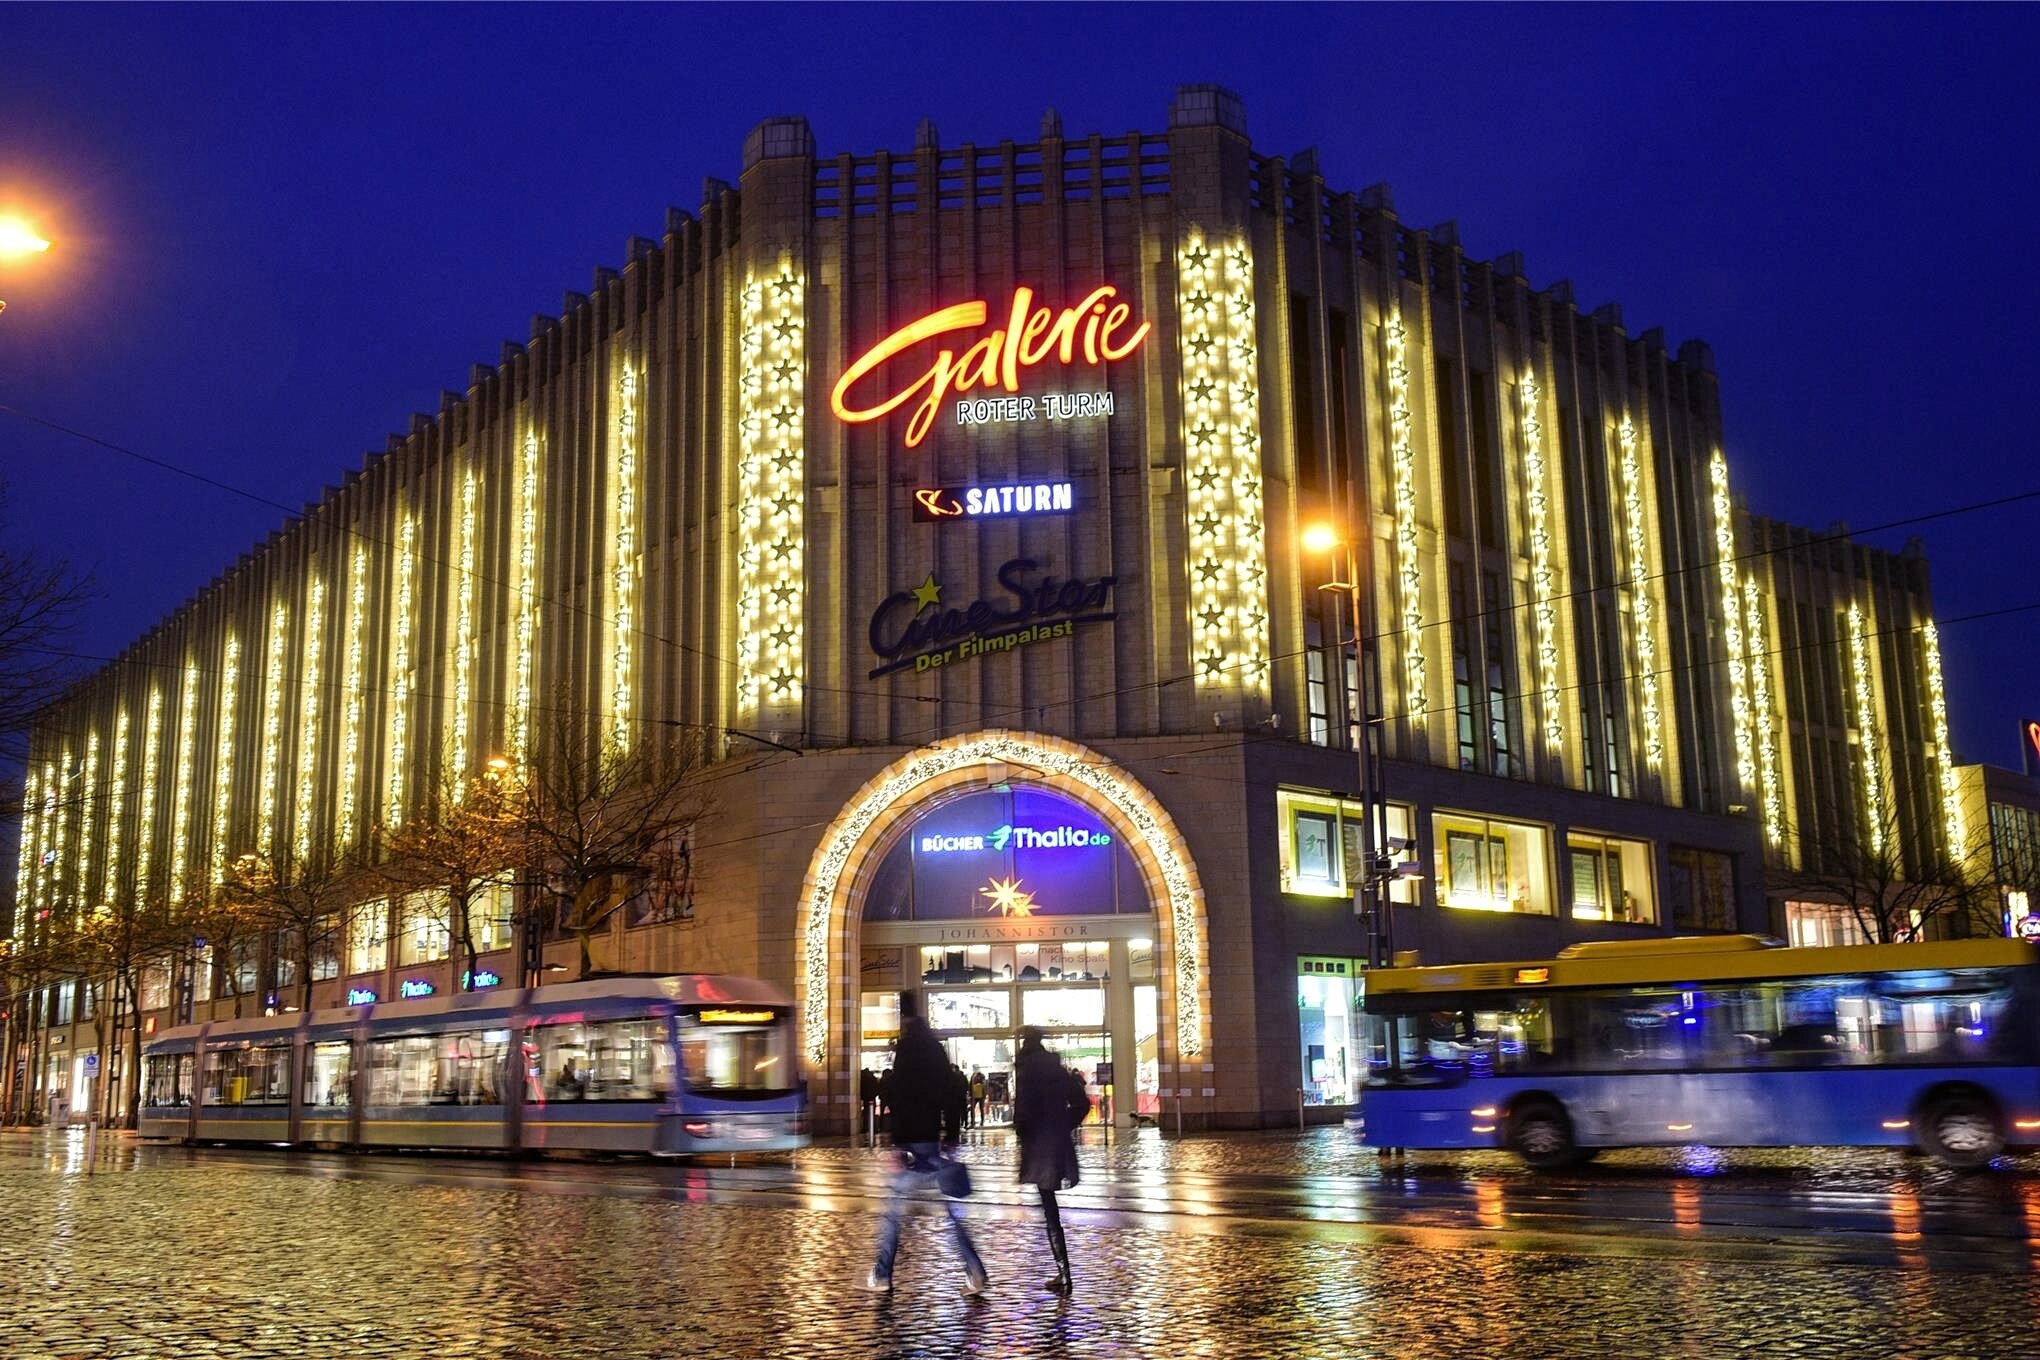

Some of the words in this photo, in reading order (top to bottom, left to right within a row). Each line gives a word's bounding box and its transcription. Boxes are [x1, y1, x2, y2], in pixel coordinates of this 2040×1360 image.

[831, 286, 1151, 448] Galerie
[957, 397, 1036, 425] ROTER
[1043, 391, 1115, 421] TURM
[966, 483, 1072, 515] SATURN
[915, 650, 954, 674] Der
[958, 619, 1074, 659] Filmpalast
[922, 834, 984, 852] BÜCHER
[940, 925, 1089, 941] JOHANNISTOR
